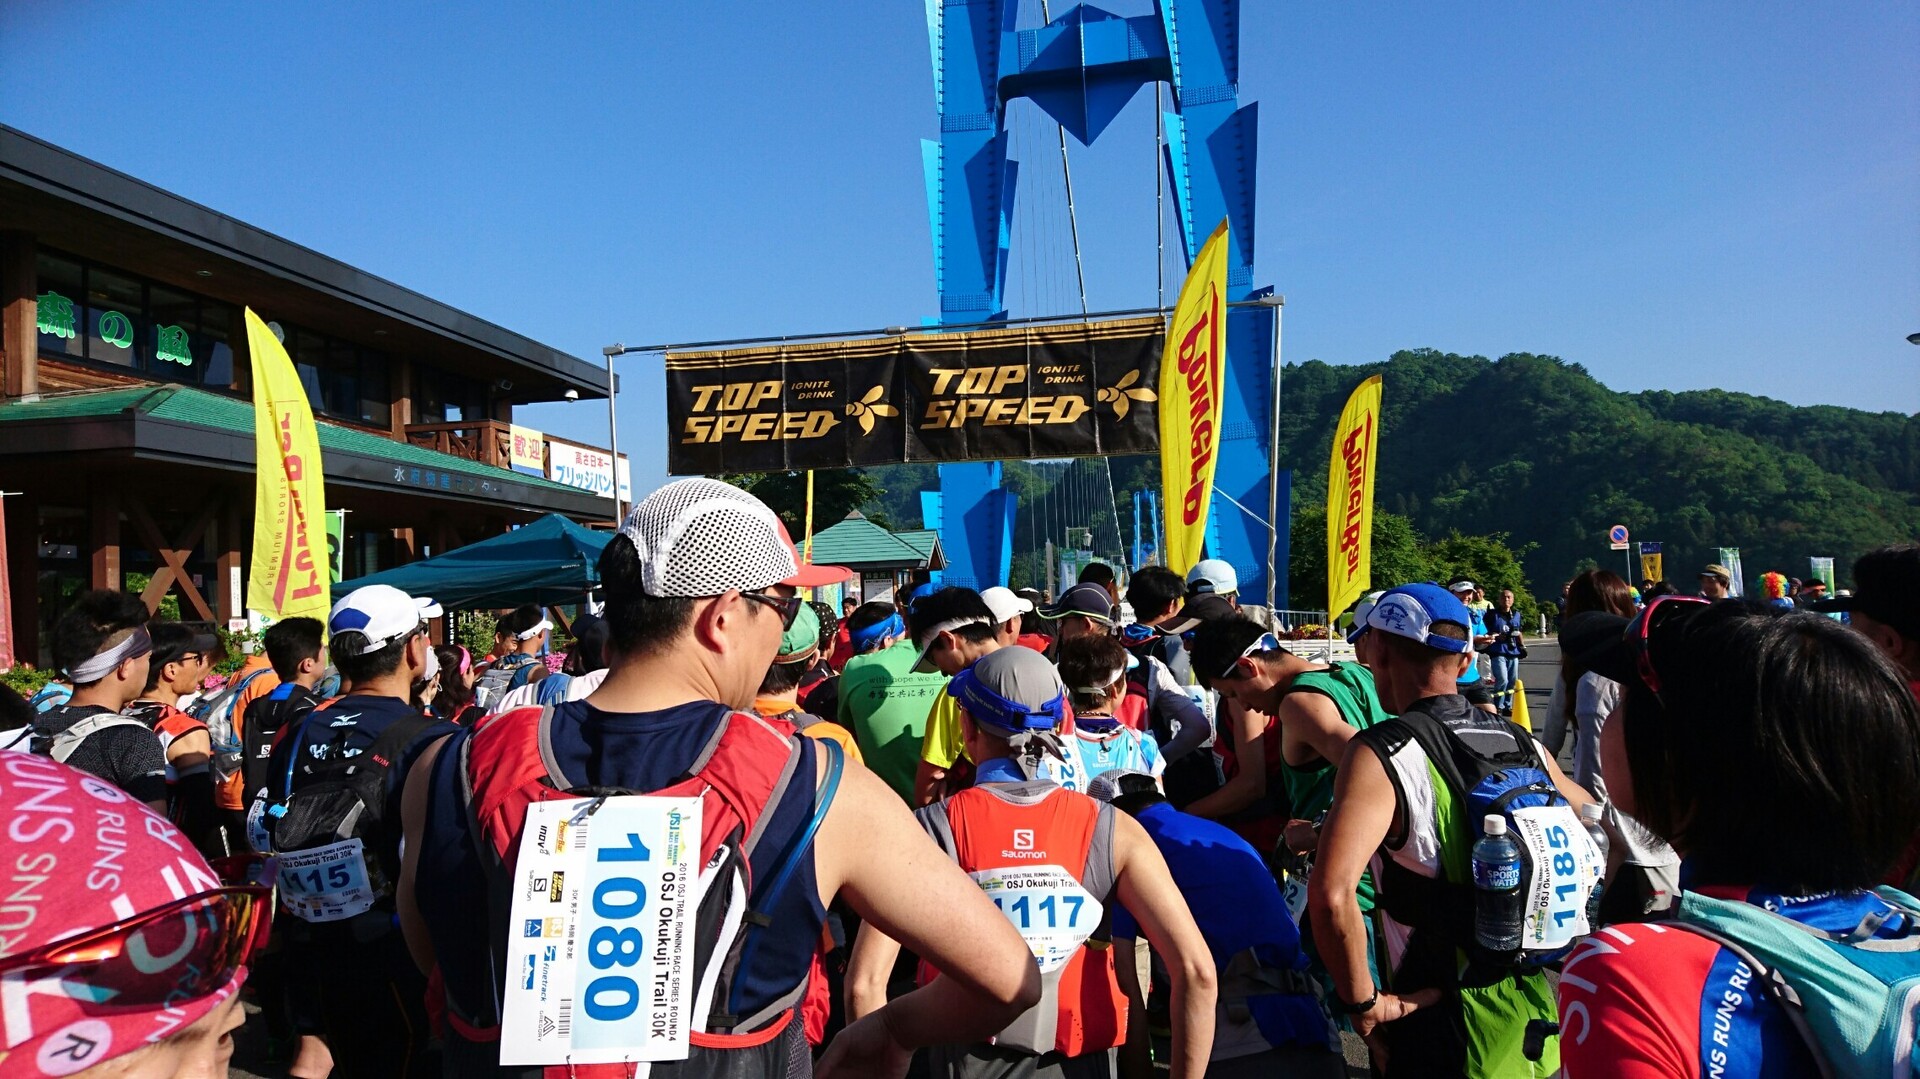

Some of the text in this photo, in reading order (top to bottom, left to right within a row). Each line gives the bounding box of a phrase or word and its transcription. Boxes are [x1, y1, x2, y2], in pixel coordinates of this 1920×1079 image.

[929, 364, 1030, 395] TOP
[1037, 364, 1080, 375] IGNITE
[1044, 374, 1086, 385] DRINK
[791, 380, 830, 391] IGNITE
[798, 390, 836, 400] DRINK
[691, 380, 784, 412] TOP
[920, 395, 1092, 430] SPEED
[681, 410, 842, 445] SPEED
[575, 452, 611, 469] 高さ日本一
[556, 465, 628, 493] ブリッジバンー
[557, 820, 568, 853] PowerBar
[1535, 834, 1546, 853] Trail
[86, 809, 127, 892] RUNS
[294, 857, 320, 867] Okukuji
[321, 854, 339, 863] Trail
[679, 862, 688, 882] 2016
[1487, 869, 1519, 879] SPORTS
[1542, 856, 1551, 889] Okukuji
[1545, 825, 1577, 928] 1185
[677, 884, 686, 898] OSJ
[1007, 880, 1024, 889] OSJ
[1026, 879, 1058, 889] Okukuji
[1490, 878, 1519, 887] WATER
[676, 900, 685, 919] TRAIL
[1540, 891, 1550, 908] OSJ
[584, 832, 651, 1022] 1080
[674, 921, 683, 953] RUNNING
[651, 871, 676, 1038] OSJ Okukuji Trail 30K
[672, 955, 682, 975] RACE
[671, 977, 680, 1003] SERIES
[1713, 990, 1743, 1048] RUNS
